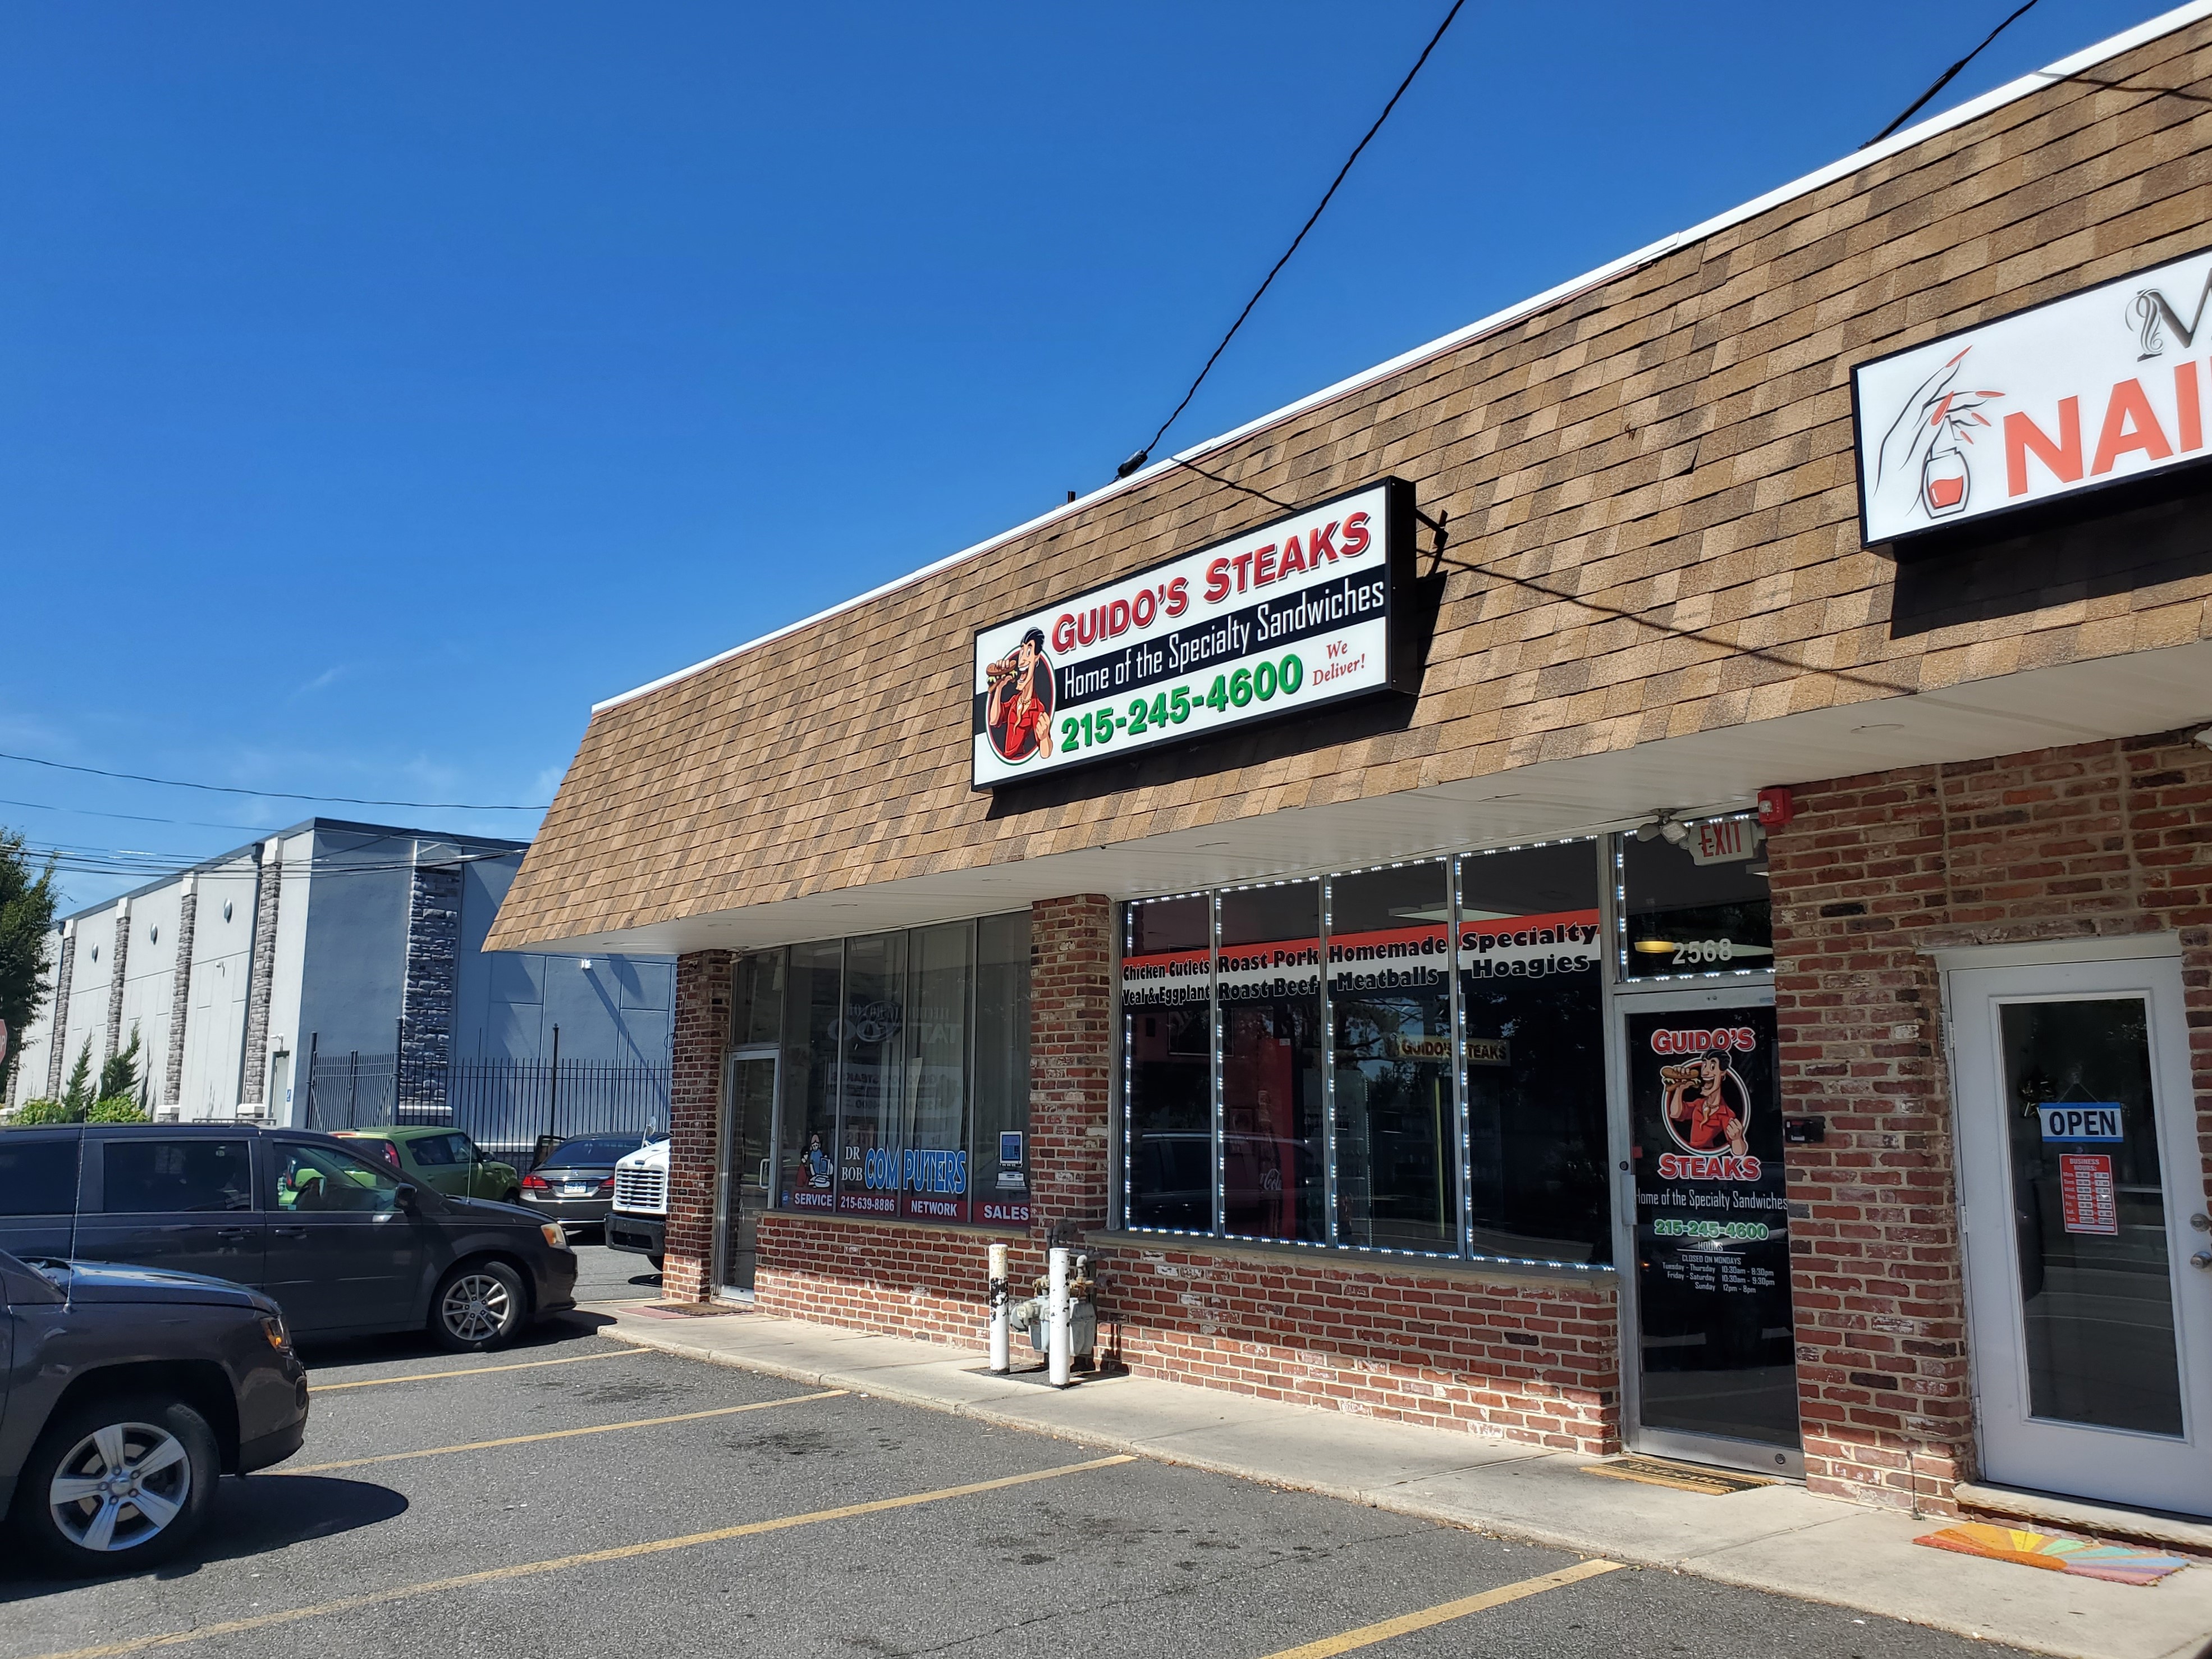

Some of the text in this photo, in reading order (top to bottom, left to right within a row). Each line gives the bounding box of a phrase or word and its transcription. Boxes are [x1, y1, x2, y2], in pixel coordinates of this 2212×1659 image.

[2003, 357, 2212, 499] NAI
[1051, 511, 1372, 655] GUIDO'S STEAKS
[1064, 578, 1385, 700] Home of the Specialty Sandwiches
[1326, 640, 1348, 660] We
[1312, 653, 1366, 686] Deliver!
[1060, 653, 1303, 752] 215-245-4600
[1700, 821, 1742, 857] EXIT
[1329, 935, 1448, 963] Homemade
[1462, 921, 1600, 954] Specialty
[1218, 946, 1319, 974] Roast Pork
[1672, 938, 1733, 965] 2568
[1123, 957, 1210, 981] Chicken Cutlets
[1472, 953, 1590, 979] Hoagies
[1218, 975, 1318, 1001] Roast Beef
[1336, 966, 1440, 991] Meatballs
[1123, 984, 1211, 1006] Veal & Eggplant
[1467, 1044, 1506, 1061] TEAKS
[1651, 1027, 1756, 1055] GUIDO'S
[2049, 1110, 2117, 1136] OPEN
[845, 1146, 860, 1160] DR
[841, 1167, 863, 1181] BOB
[1657, 1152, 1762, 1182] STEAKS
[794, 1192, 832, 1207] SERVICE
[840, 1196, 895, 1212] 215-639-8886
[911, 1200, 958, 1217] NETWORK
[1661, 1189, 1671, 1205] of
[1672, 1187, 1687, 1206] the
[1689, 1189, 1730, 1211] Specialty
[1733, 1190, 1788, 1210] Sandwiches
[984, 1205, 1029, 1221] SALES
[1654, 1219, 1769, 1241] 215-245-4600
[1698, 1241, 1724, 1252] HOURS
[1663, 1262, 1684, 1272] Tuesday
[1690, 1264, 1715, 1274] Thursday
[1721, 1265, 1746, 1274] 10:30am
[1751, 1268, 1774, 1277] 8:30pm
[1682, 1254, 1703, 1263] CLOSED
[1714, 1256, 1742, 1265] MONDAYS
[1667, 1271, 1684, 1281] Friday
[1690, 1273, 1715, 1282] Saturday
[1722, 1274, 1746, 1283] 10:30am
[1752, 1277, 1775, 1286] 9:30pm
[1695, 1282, 1715, 1292] Sunday
[1723, 1284, 1737, 1293] 12pm
[1743, 1286, 1756, 1295] 8pm
